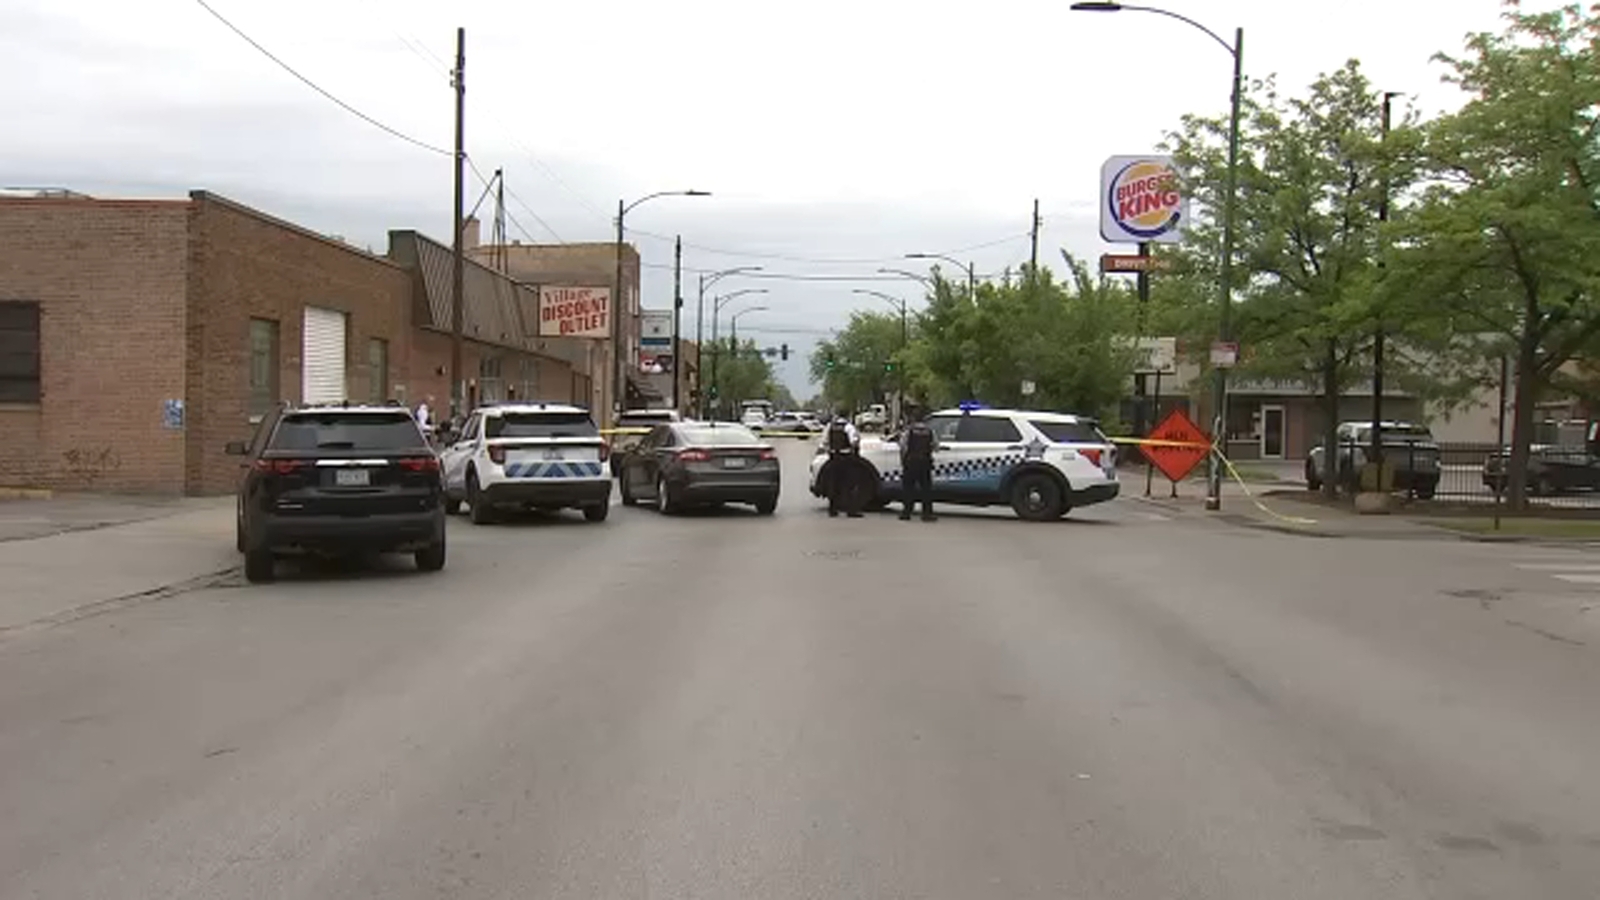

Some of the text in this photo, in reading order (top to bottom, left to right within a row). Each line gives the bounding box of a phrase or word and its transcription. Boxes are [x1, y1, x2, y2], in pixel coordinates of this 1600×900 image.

[1119, 189, 1178, 221] KING
[541, 296, 608, 323] DISCOUNT
[559, 312, 607, 335] OUTLET
